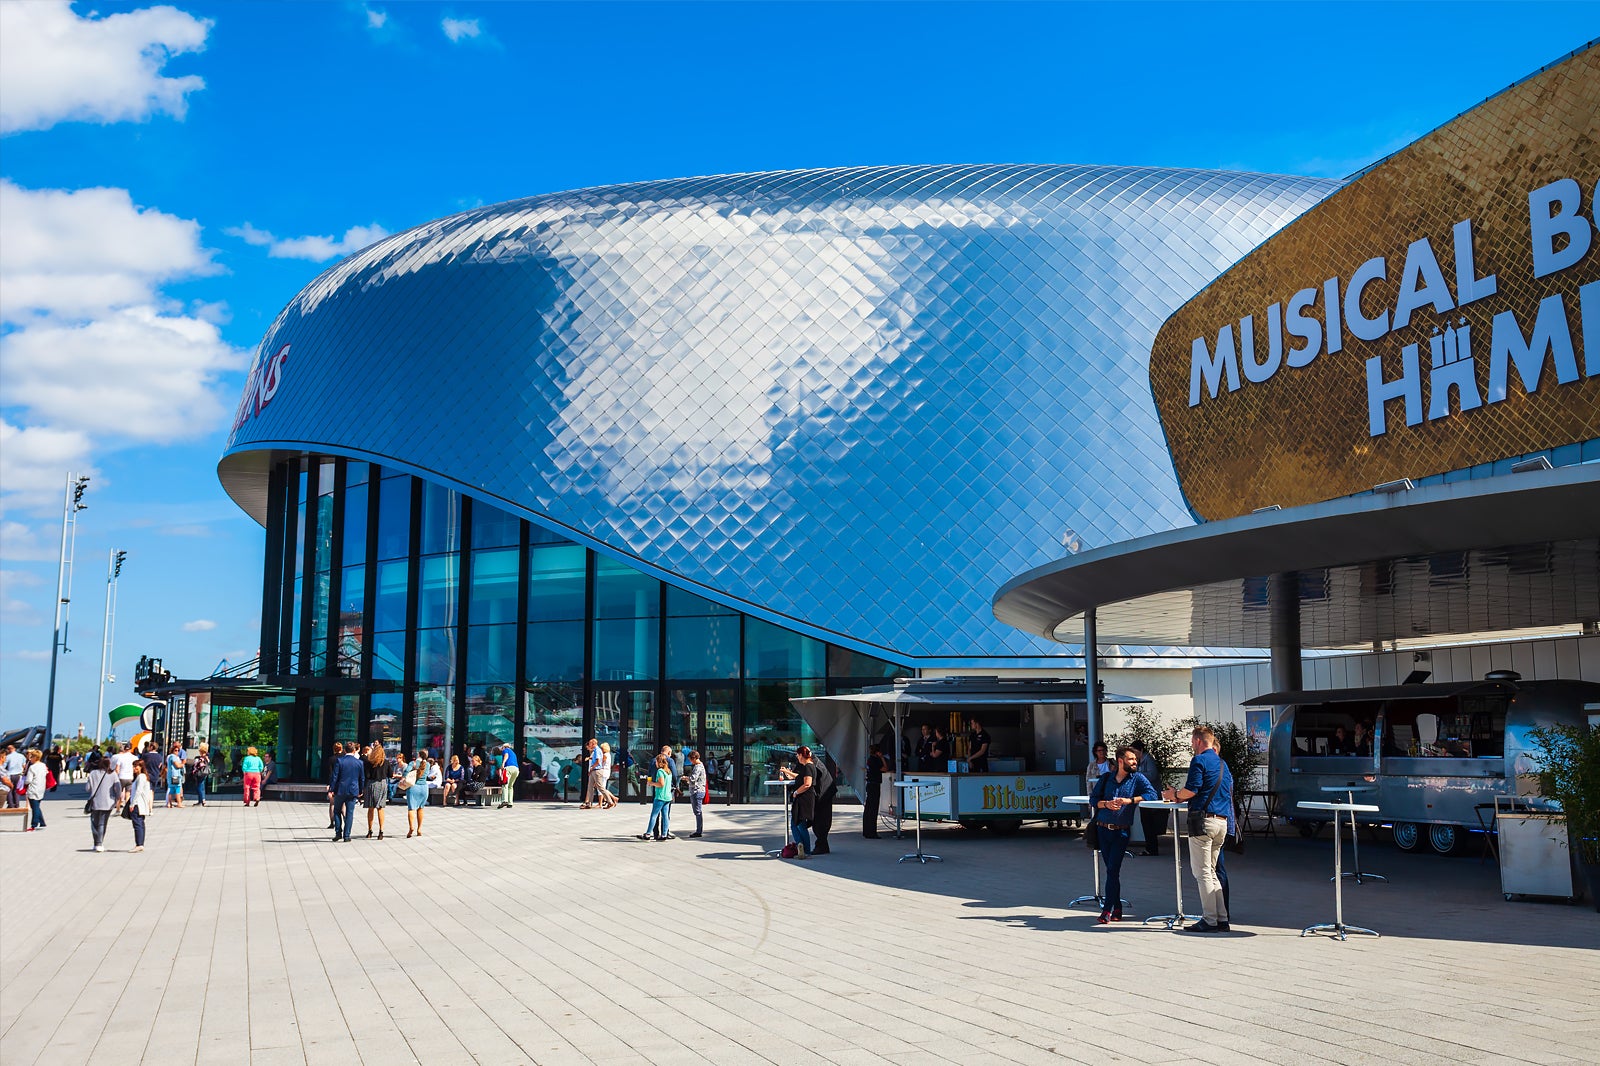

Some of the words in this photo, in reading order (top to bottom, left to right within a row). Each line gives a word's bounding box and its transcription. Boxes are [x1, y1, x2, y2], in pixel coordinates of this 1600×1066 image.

[1189, 219, 1497, 408] MUSICAL
[1528, 178, 1600, 279] B
[982, 784, 1058, 812] Bitburger
